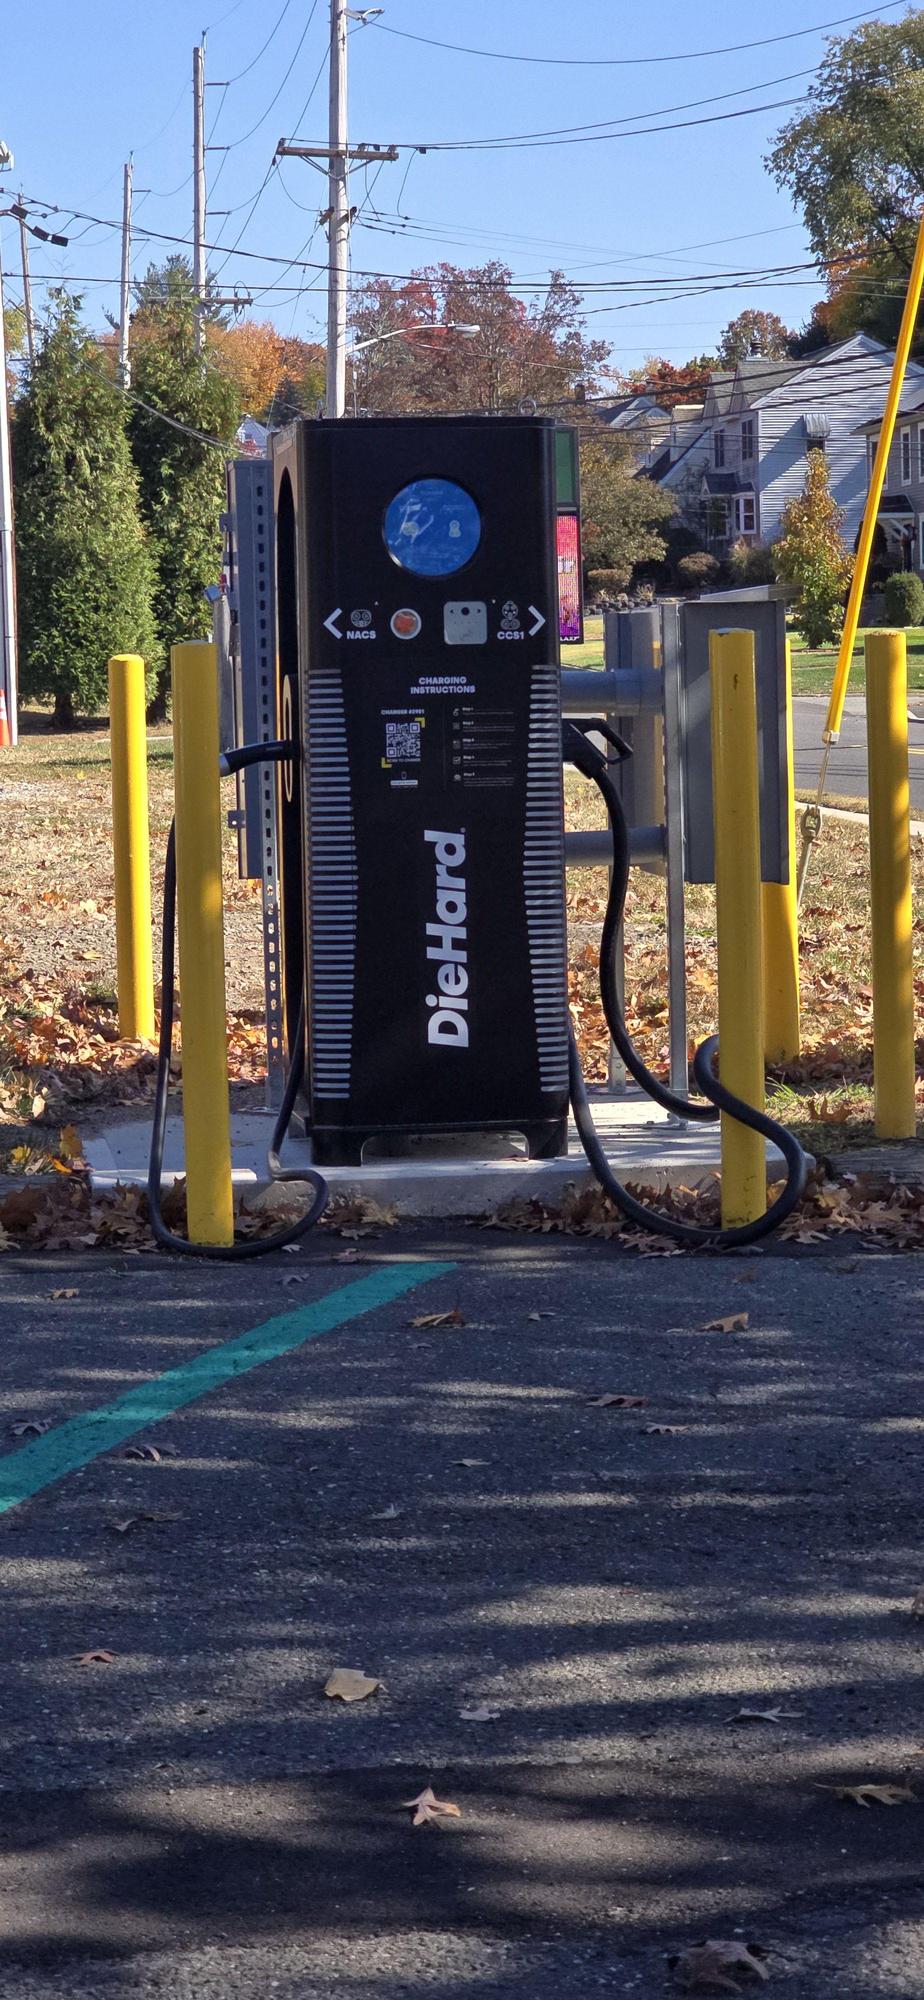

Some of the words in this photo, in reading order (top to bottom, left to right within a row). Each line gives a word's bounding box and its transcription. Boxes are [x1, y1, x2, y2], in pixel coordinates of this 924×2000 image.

[346, 630, 377, 640] NACS
[496, 630, 525, 640] CCS1
[418, 676, 467, 685] CHARGING
[410, 685, 476, 695] INSTRUCTIONS
[424, 829, 469, 1048] DieHard
